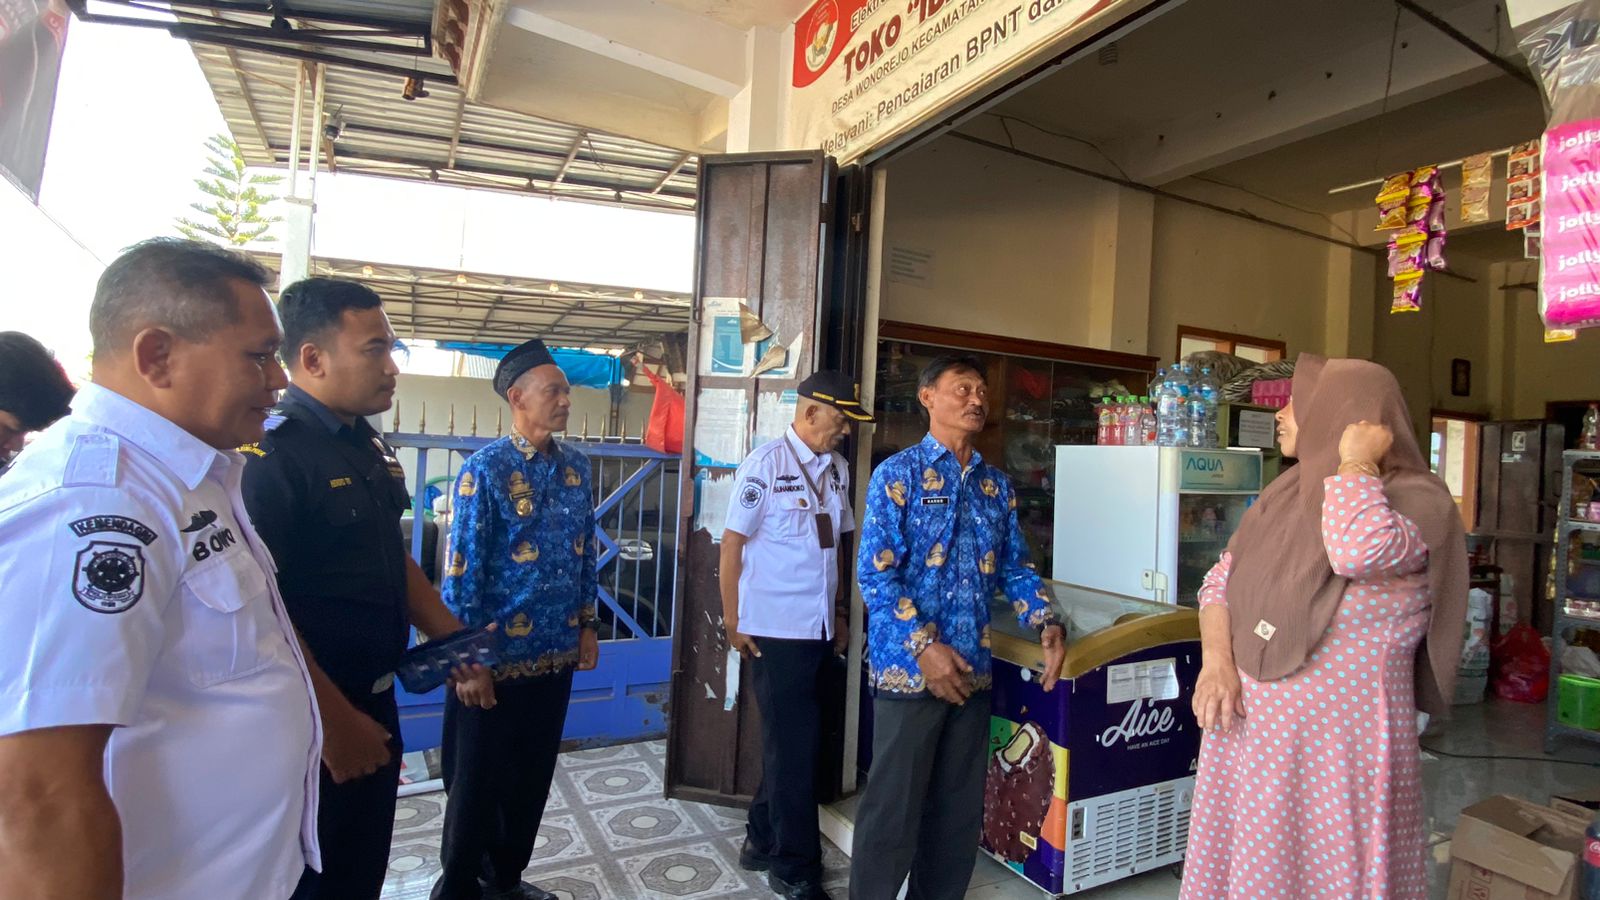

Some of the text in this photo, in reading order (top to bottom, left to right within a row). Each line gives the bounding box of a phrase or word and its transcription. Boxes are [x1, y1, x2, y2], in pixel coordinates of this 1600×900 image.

[844, 14, 902, 82] TOKO
[966, 5, 1021, 62] BPNT
[832, 90, 854, 114] DESA
[855, 46, 909, 96] WONOREJO
[1186, 457, 1224, 471] AQUA
[1101, 698, 1175, 747] Aice
